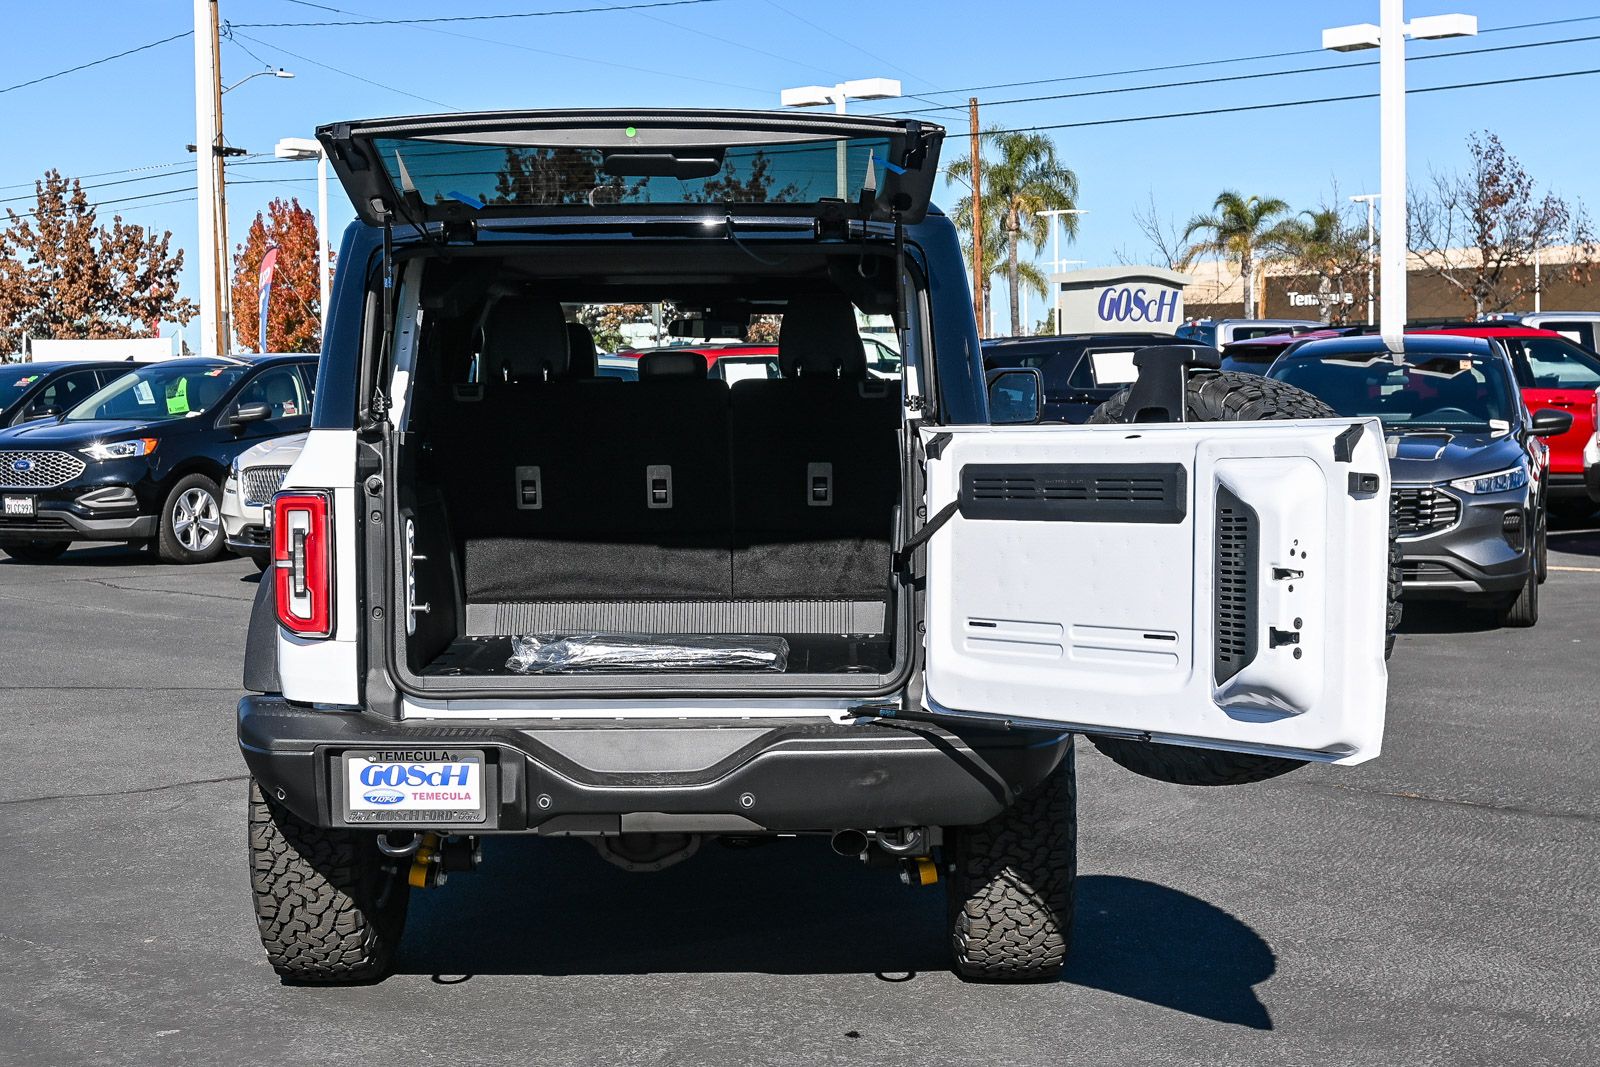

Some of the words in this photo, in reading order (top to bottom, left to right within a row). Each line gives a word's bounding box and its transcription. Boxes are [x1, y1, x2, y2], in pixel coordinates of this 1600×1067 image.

[1287, 291, 1354, 307] Temua
[377, 751, 450, 762] TEMECULA
[412, 792, 471, 801] TEMECULA
